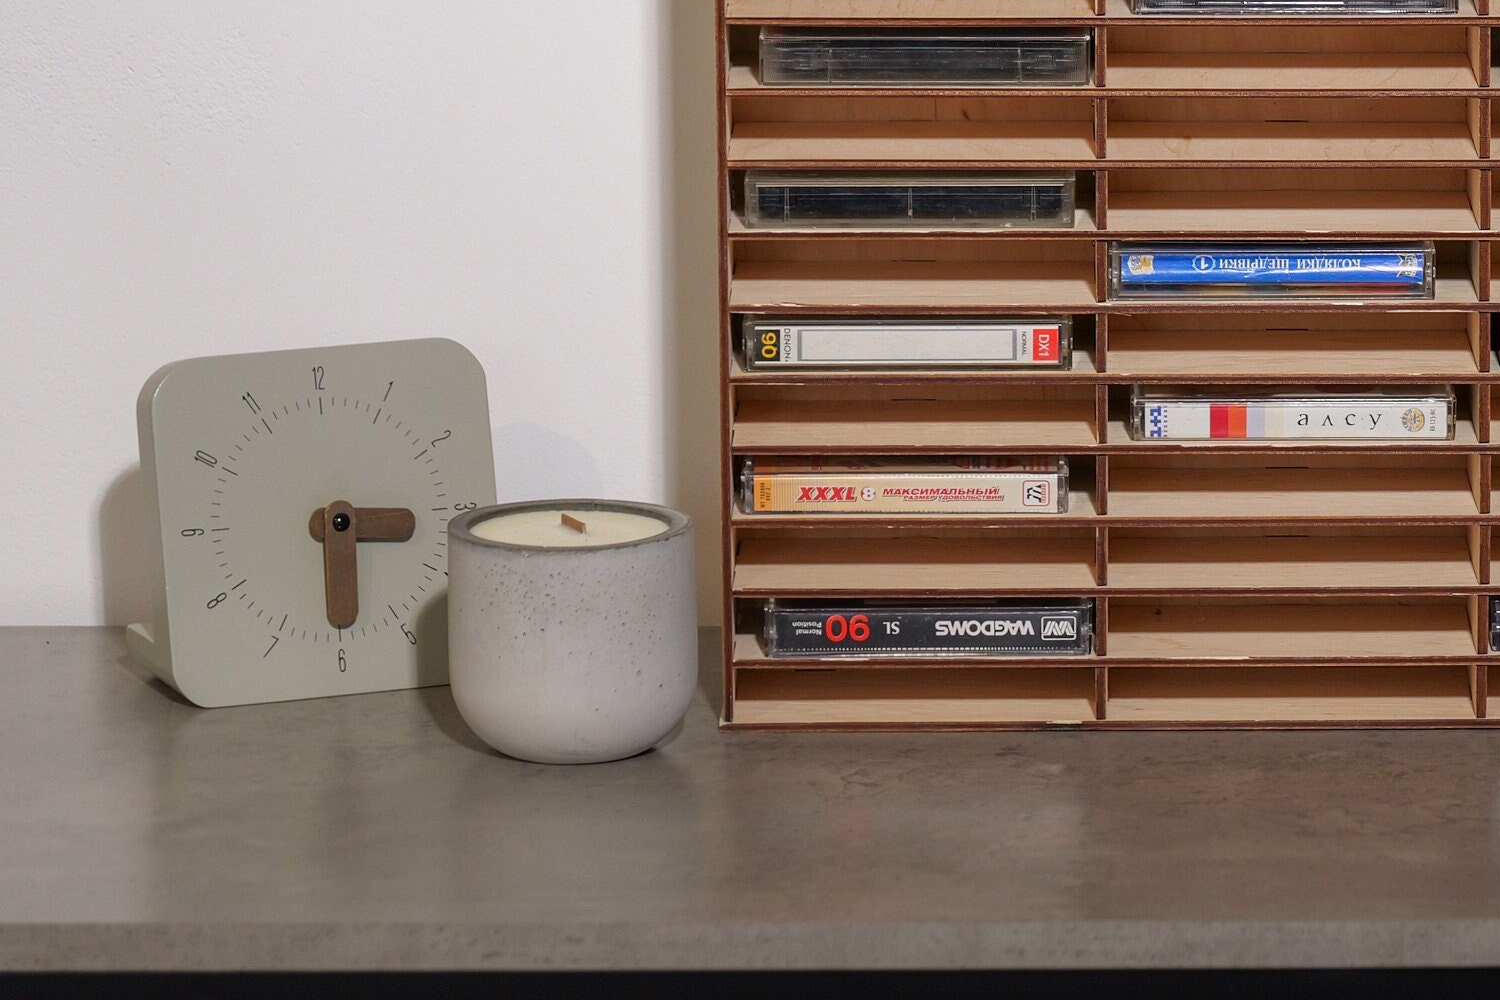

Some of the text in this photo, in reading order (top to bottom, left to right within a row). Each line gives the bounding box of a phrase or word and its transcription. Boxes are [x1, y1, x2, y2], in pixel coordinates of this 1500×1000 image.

[1297, 257, 1361, 271] КОЛЯДКИ
[760, 331, 777, 359] 90
[783, 328, 791, 358] DENON
[1037, 333, 1049, 358] DX1
[312, 366, 325, 391] 12
[383, 380, 394, 402] 1
[241, 391, 261, 415] 11
[1149, 406, 1162, 437] 1+1
[431, 430, 452, 449] 2
[194, 449, 218, 468] 10
[796, 486, 876, 502] XXXL 8
[882, 485, 999, 497] МАКСИМАЛЬНЫЙ
[454, 501, 477, 512] 3
[181, 527, 205, 538] 9
[206, 592, 228, 610] 8
[792, 621, 822, 629] Position
[795, 627, 822, 635] Normal
[825, 614, 870, 641] 90
[883, 620, 900, 634] SL
[935, 620, 1035, 636] WAGDOMS
[400, 624, 418, 646] 5
[263, 636, 279, 658] 7
[338, 648, 347, 673] 6
